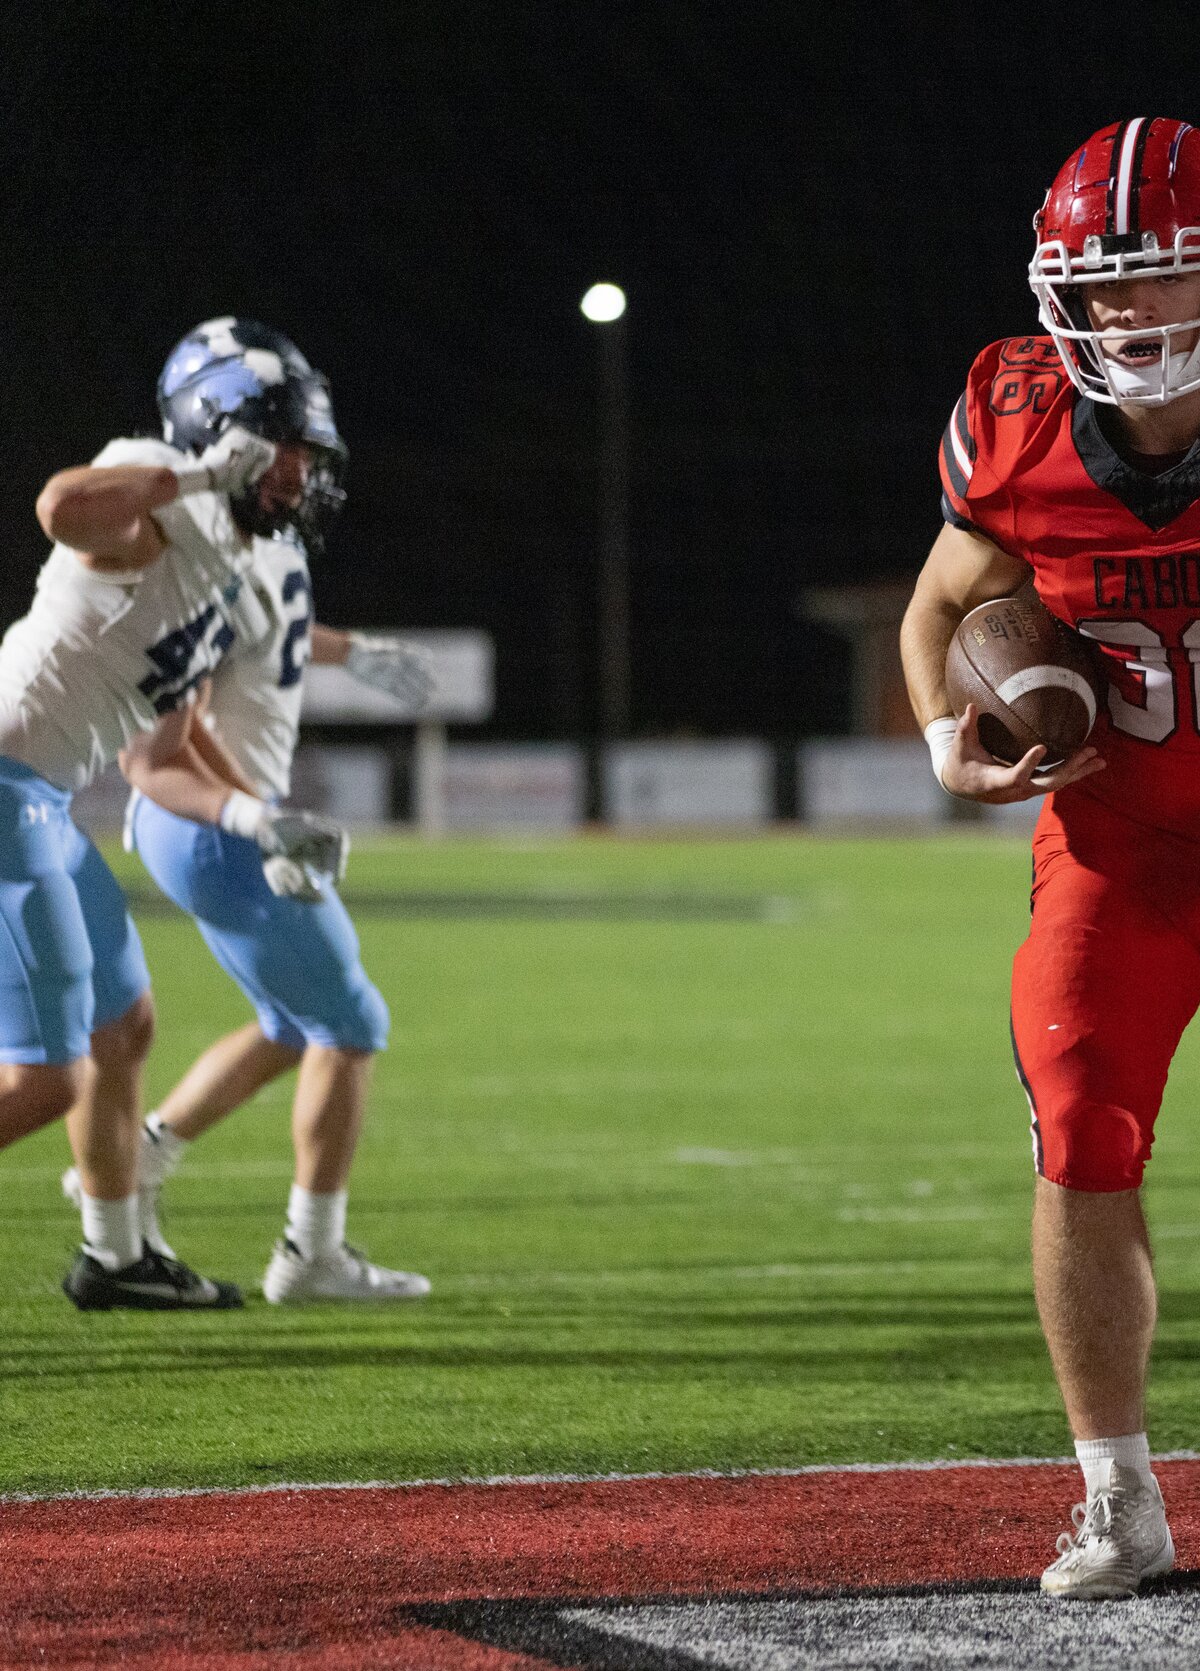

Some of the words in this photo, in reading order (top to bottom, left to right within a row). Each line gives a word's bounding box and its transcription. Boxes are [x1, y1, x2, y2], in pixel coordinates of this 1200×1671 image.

[989, 338, 1064, 417] 36
[971, 626, 987, 647] NCAA
[984, 614, 1010, 641] GST
